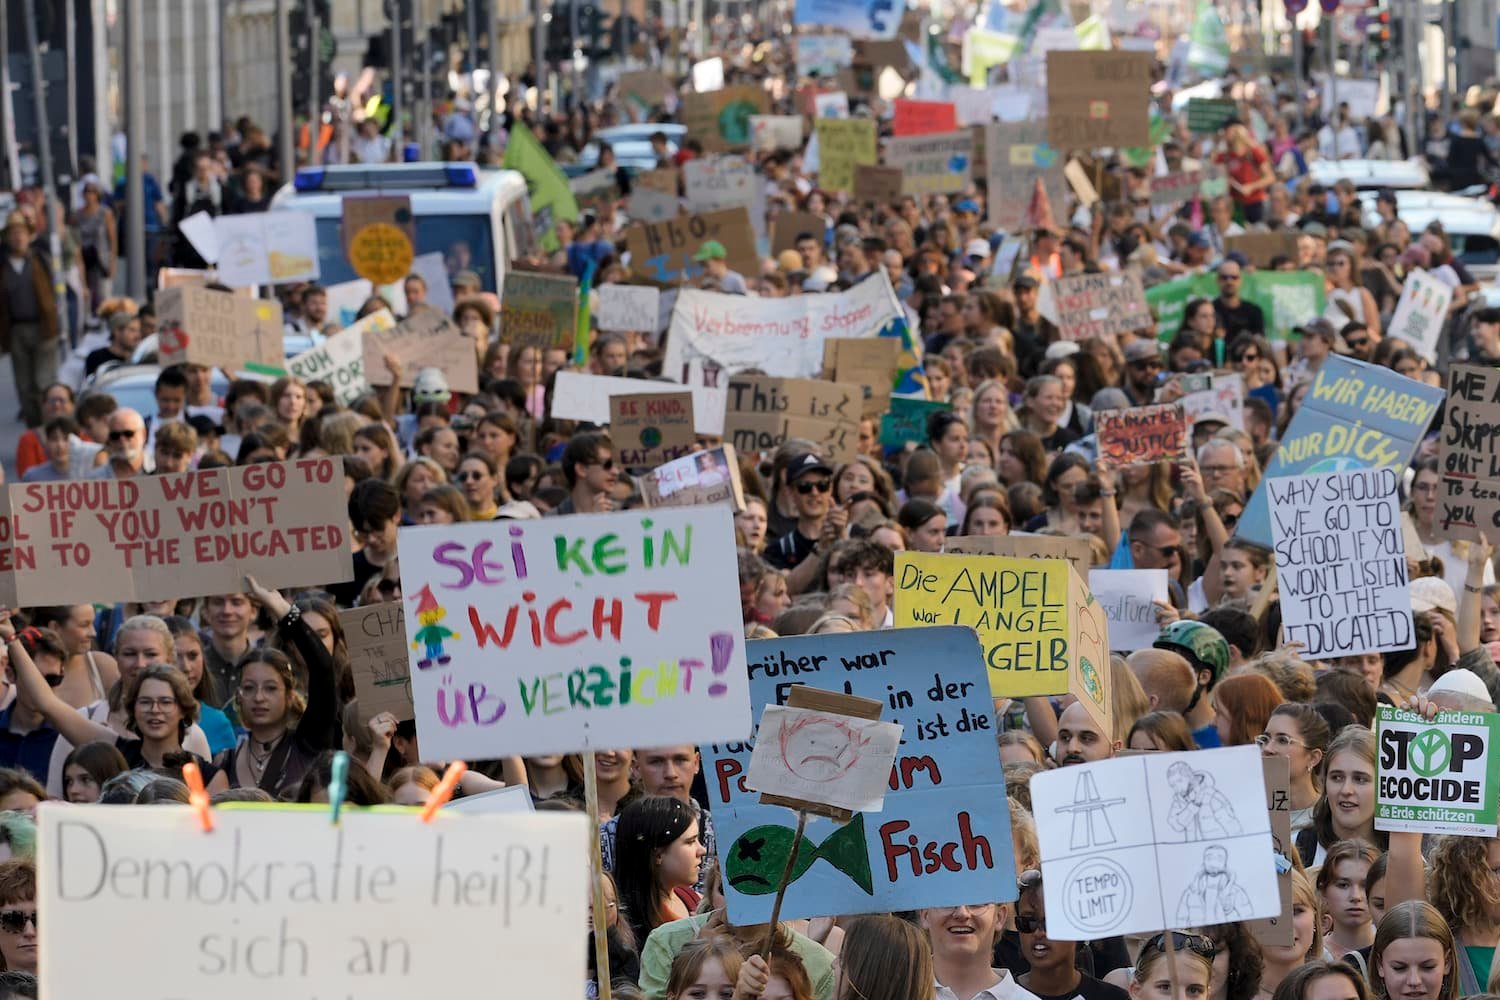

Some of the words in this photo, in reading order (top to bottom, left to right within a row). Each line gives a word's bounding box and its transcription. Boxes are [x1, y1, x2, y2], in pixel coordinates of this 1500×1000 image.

[693, 303, 810, 338] Verbrennung
[821, 303, 873, 333] stoppen
[729, 382, 788, 412] This
[1312, 370, 1365, 406] WIR
[1362, 385, 1438, 427] HABEN
[1451, 371, 1486, 402] WE
[620, 448, 650, 465] EAT
[1278, 433, 1323, 468] NUR
[23, 481, 140, 512] SHOULD
[160, 471, 219, 501] WE
[243, 463, 286, 491] GO
[296, 459, 333, 483] TO
[1270, 478, 1320, 506] WHY
[1324, 469, 1397, 502] SHOULD
[50, 511, 75, 538] IF
[97, 509, 160, 543] YOU
[177, 496, 278, 532] WON'T
[1274, 510, 1321, 538] WE
[1325, 504, 1350, 531] GO
[1357, 501, 1392, 528] TO
[52, 543, 91, 567] TO
[115, 539, 180, 568] THE
[195, 525, 343, 563] EDUCATED
[1275, 534, 1349, 568] SCHOOL
[1352, 529, 1368, 561] IF
[1371, 528, 1404, 557] YOU
[900, 563, 938, 593] Die
[941, 568, 1064, 609] AMPEL
[1281, 564, 1345, 597] WON'T
[1351, 558, 1406, 588] LISTEN
[1300, 593, 1334, 620] TO
[1341, 586, 1393, 614] THE
[1286, 611, 1410, 655] EDUCATED
[840, 649, 897, 672] war
[436, 674, 507, 728] ÜB
[889, 684, 914, 710] in
[927, 673, 976, 702] der
[917, 713, 951, 742] ist
[956, 708, 991, 733] die
[1395, 710, 1436, 724] Gese
[1380, 728, 1485, 778] STOP
[1380, 776, 1481, 804] ECOCIDE
[1391, 807, 1415, 820] Erde
[1417, 808, 1476, 823] schützen
[56, 820, 397, 904] Demokratie
[879, 811, 994, 883] Fisch
[1076, 873, 1119, 895] TEMPO
[1078, 893, 1118, 920] LIMIT
[198, 917, 310, 978] sich
[347, 933, 411, 977] an
